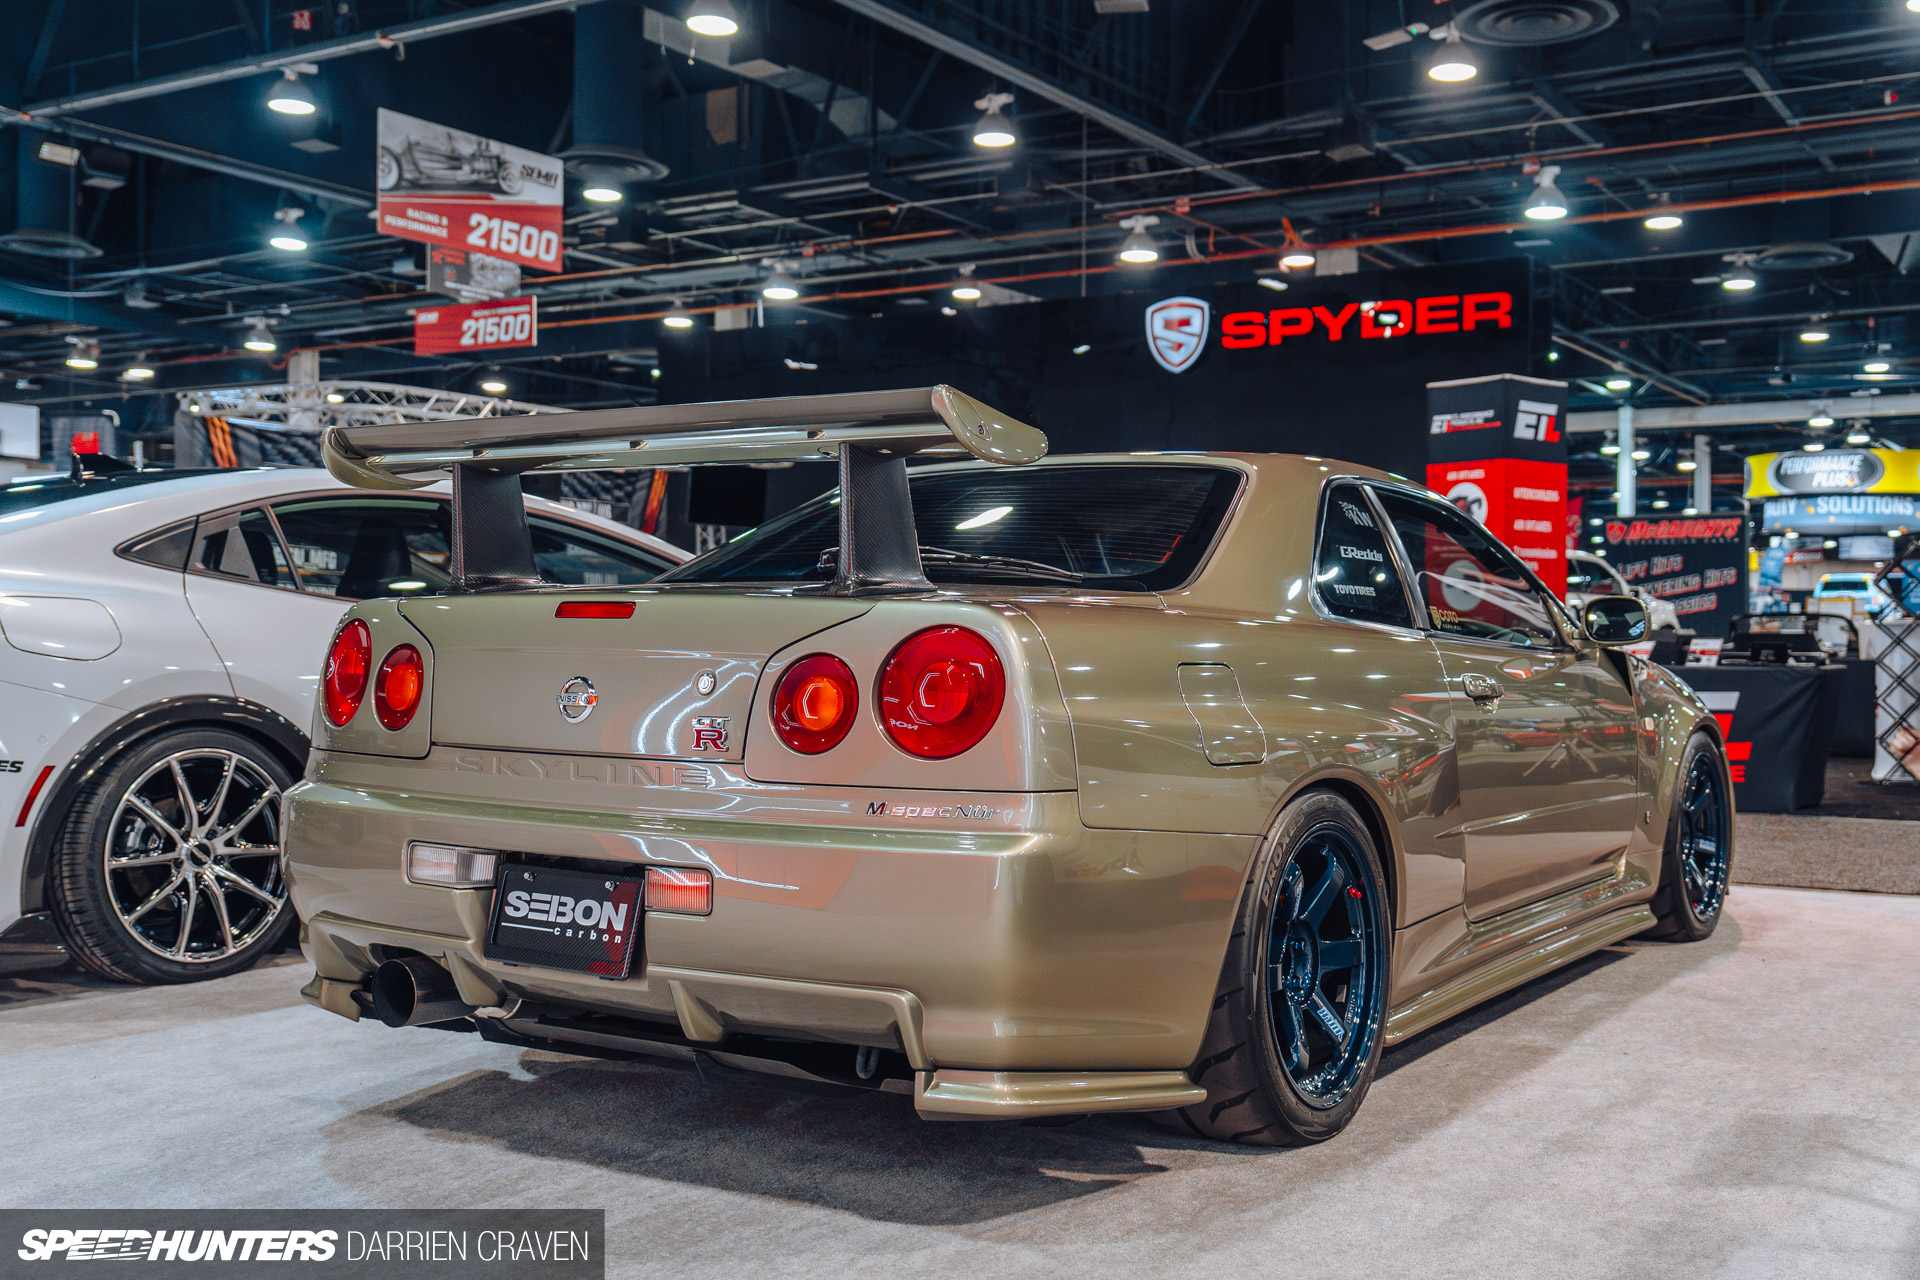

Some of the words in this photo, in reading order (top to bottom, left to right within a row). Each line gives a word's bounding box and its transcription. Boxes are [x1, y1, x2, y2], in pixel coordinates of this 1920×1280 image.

[384, 215, 448, 238] PERFORMANCE
[406, 208, 440, 225] RACING
[466, 213, 559, 263] 21500
[460, 313, 531, 346] 21500
[1221, 292, 1512, 350] SPYDER
[1780, 454, 1864, 476] PERFORMANCE
[1816, 496, 1914, 516] SOLUTIONS
[1340, 545, 1383, 562] GReddy
[559, 694, 591, 705] NISSAN
[454, 755, 716, 788] SKYLINE
[1262, 807, 1305, 909] PROXES
[504, 890, 628, 931] SEBON
[554, 926, 622, 943] carbon
